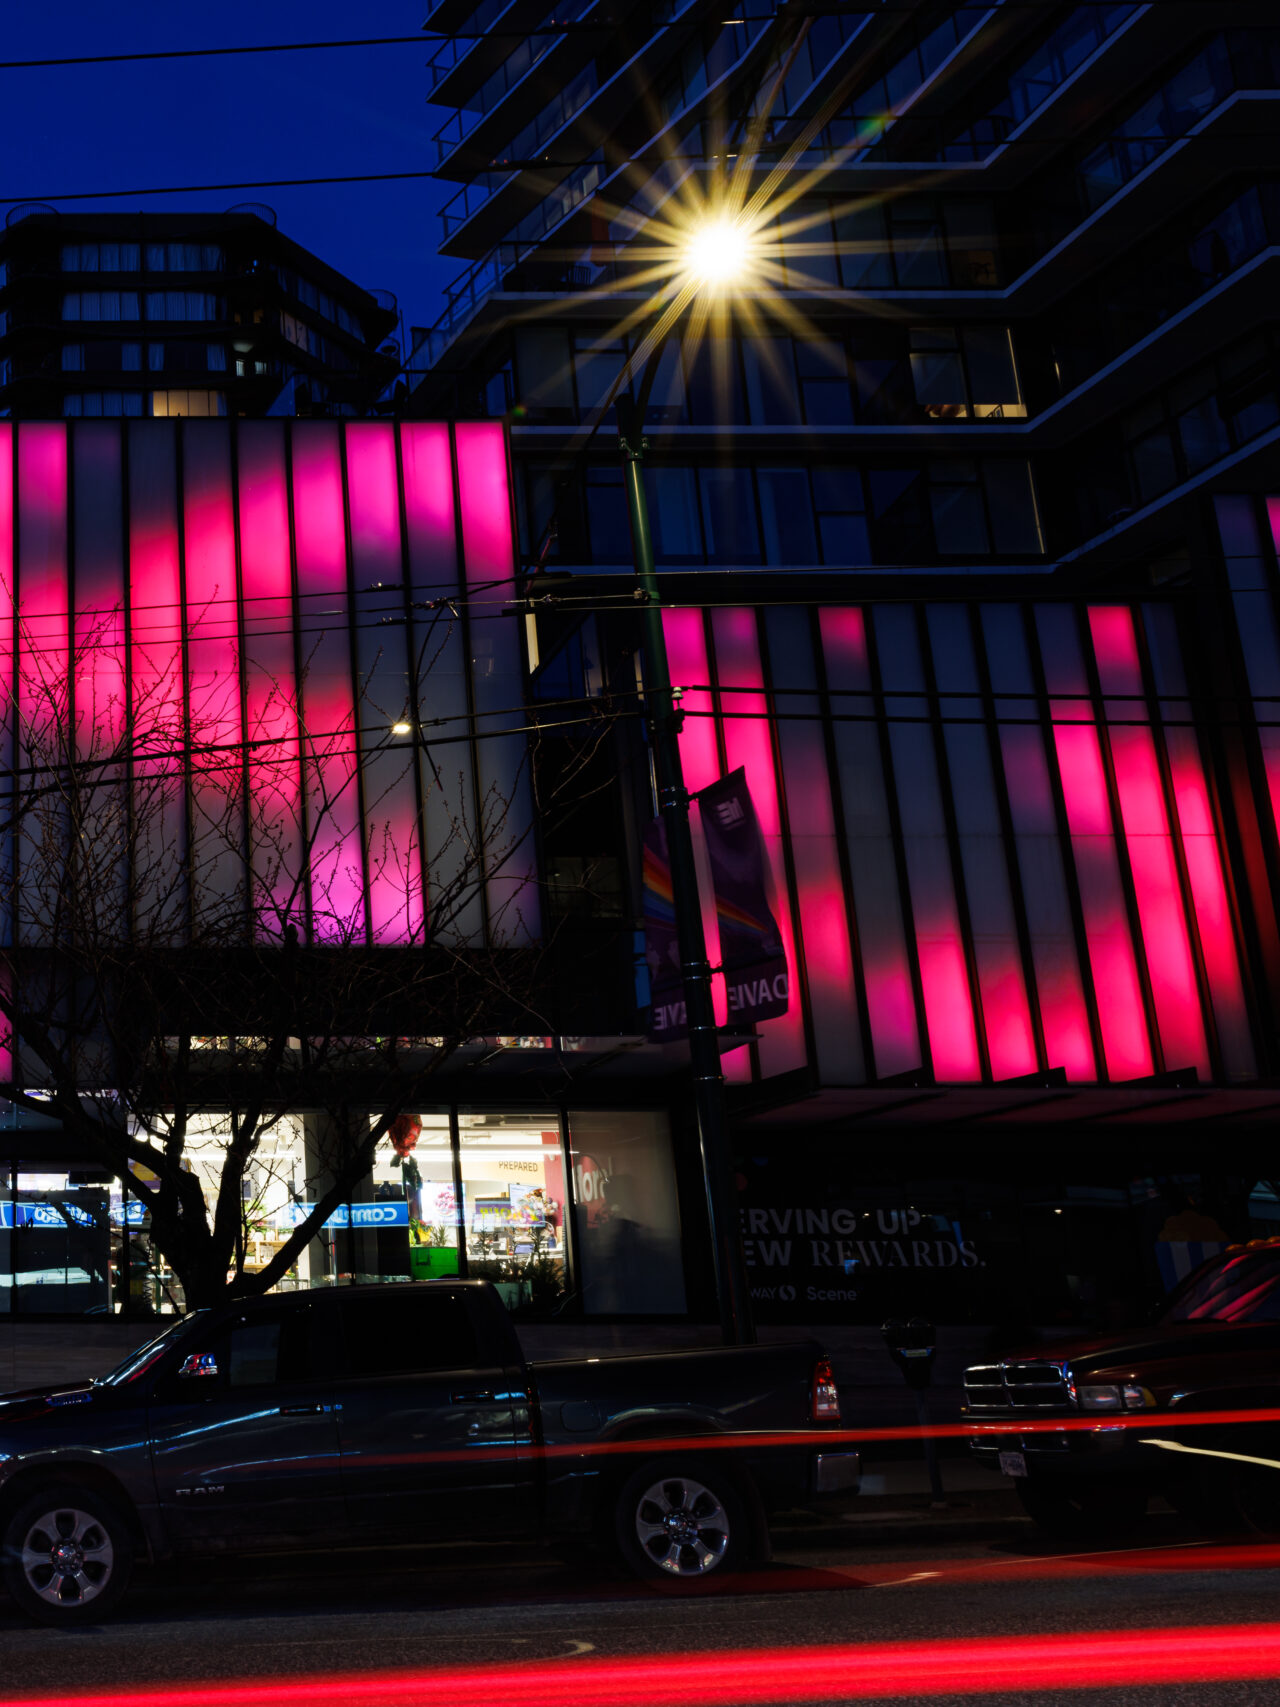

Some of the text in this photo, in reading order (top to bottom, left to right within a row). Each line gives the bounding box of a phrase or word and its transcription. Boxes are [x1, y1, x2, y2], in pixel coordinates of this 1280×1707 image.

[498, 1161, 538, 1172] PREPARED
[876, 1208, 920, 1235] UP
[744, 1240, 986, 1268] EW REWARDS.
[807, 1286, 857, 1301] Scene
